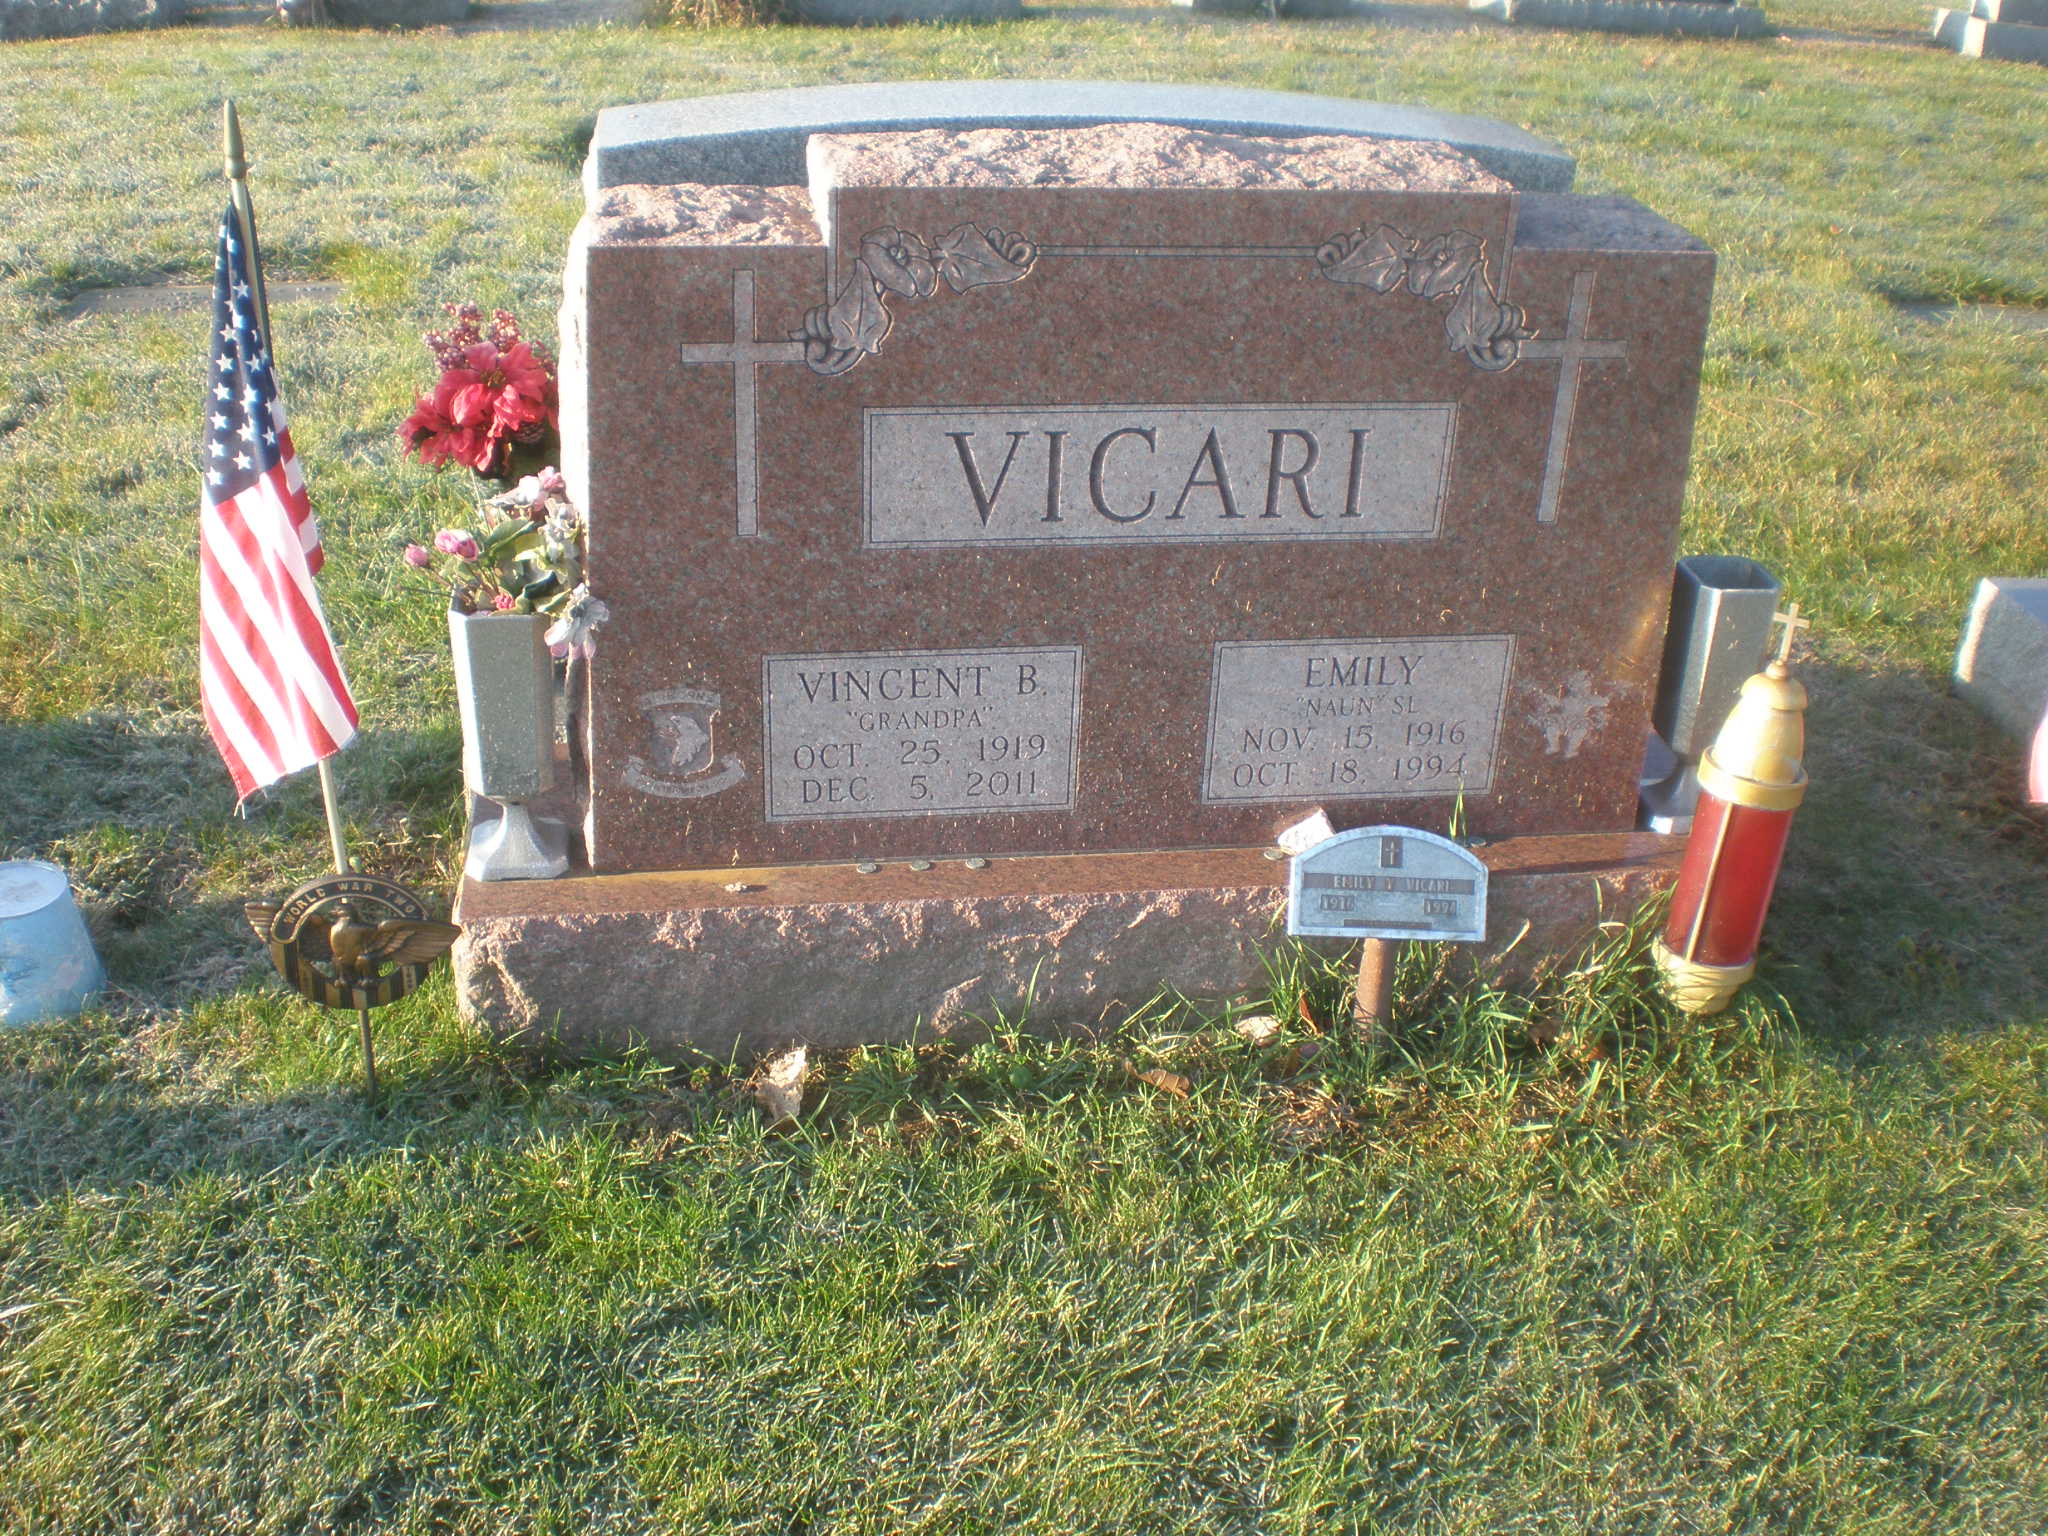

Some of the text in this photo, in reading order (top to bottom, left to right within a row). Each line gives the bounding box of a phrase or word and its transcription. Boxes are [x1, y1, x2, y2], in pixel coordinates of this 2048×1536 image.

[945, 426, 1371, 527] VICARI
[797, 664, 1047, 703] VINCENT B.
[1305, 655, 1424, 687] EMILY
[848, 706, 994, 732] "GRANDPA"
[1242, 720, 1466, 752] NOV. 15, 1916
[793, 734, 1046, 770] OCT. 25, 1919
[801, 770, 1037, 804] DEC. 5, 2011
[1233, 753, 1466, 788] OCT. 18, 1994
[1333, 875, 1374, 889] EMILY
[1406, 878, 1450, 892] VICARI
[283, 882, 416, 925] WORLD WAR TWO
